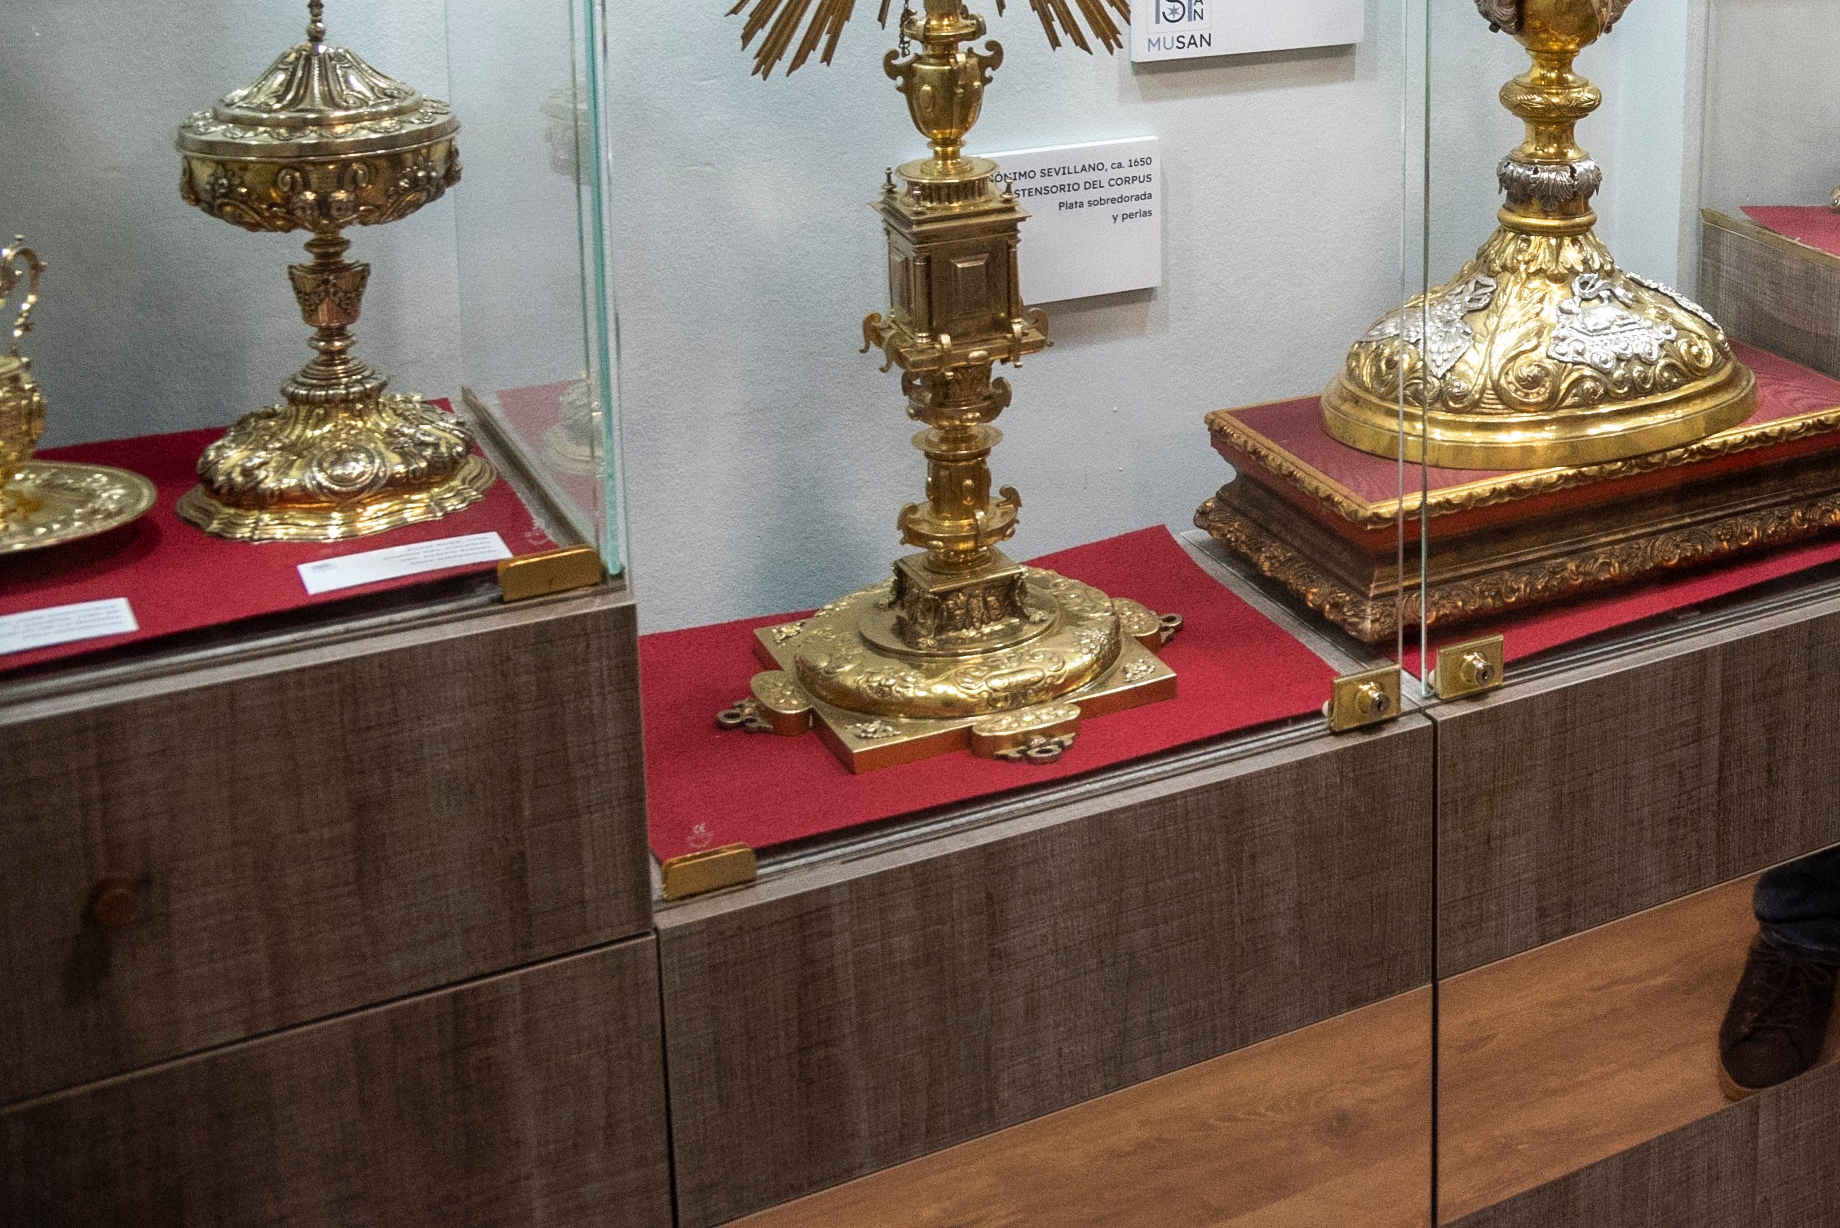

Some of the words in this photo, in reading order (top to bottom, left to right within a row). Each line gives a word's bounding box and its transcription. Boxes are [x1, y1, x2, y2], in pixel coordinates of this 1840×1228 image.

[1147, 33, 1212, 52] MUSAN
[1040, 162, 1108, 178] SEVILLANO,
[1110, 161, 1125, 170] ca.
[1128, 156, 1153, 168] 1650
[1014, 182, 1081, 199] STENSORIO
[1083, 179, 1105, 191] DEL
[1107, 173, 1153, 187] CORPUS
[1058, 199, 1085, 211] Plata
[1087, 191, 1153, 208] sobredorada
[1112, 213, 1119, 224] y
[1121, 208, 1153, 222] perlas
